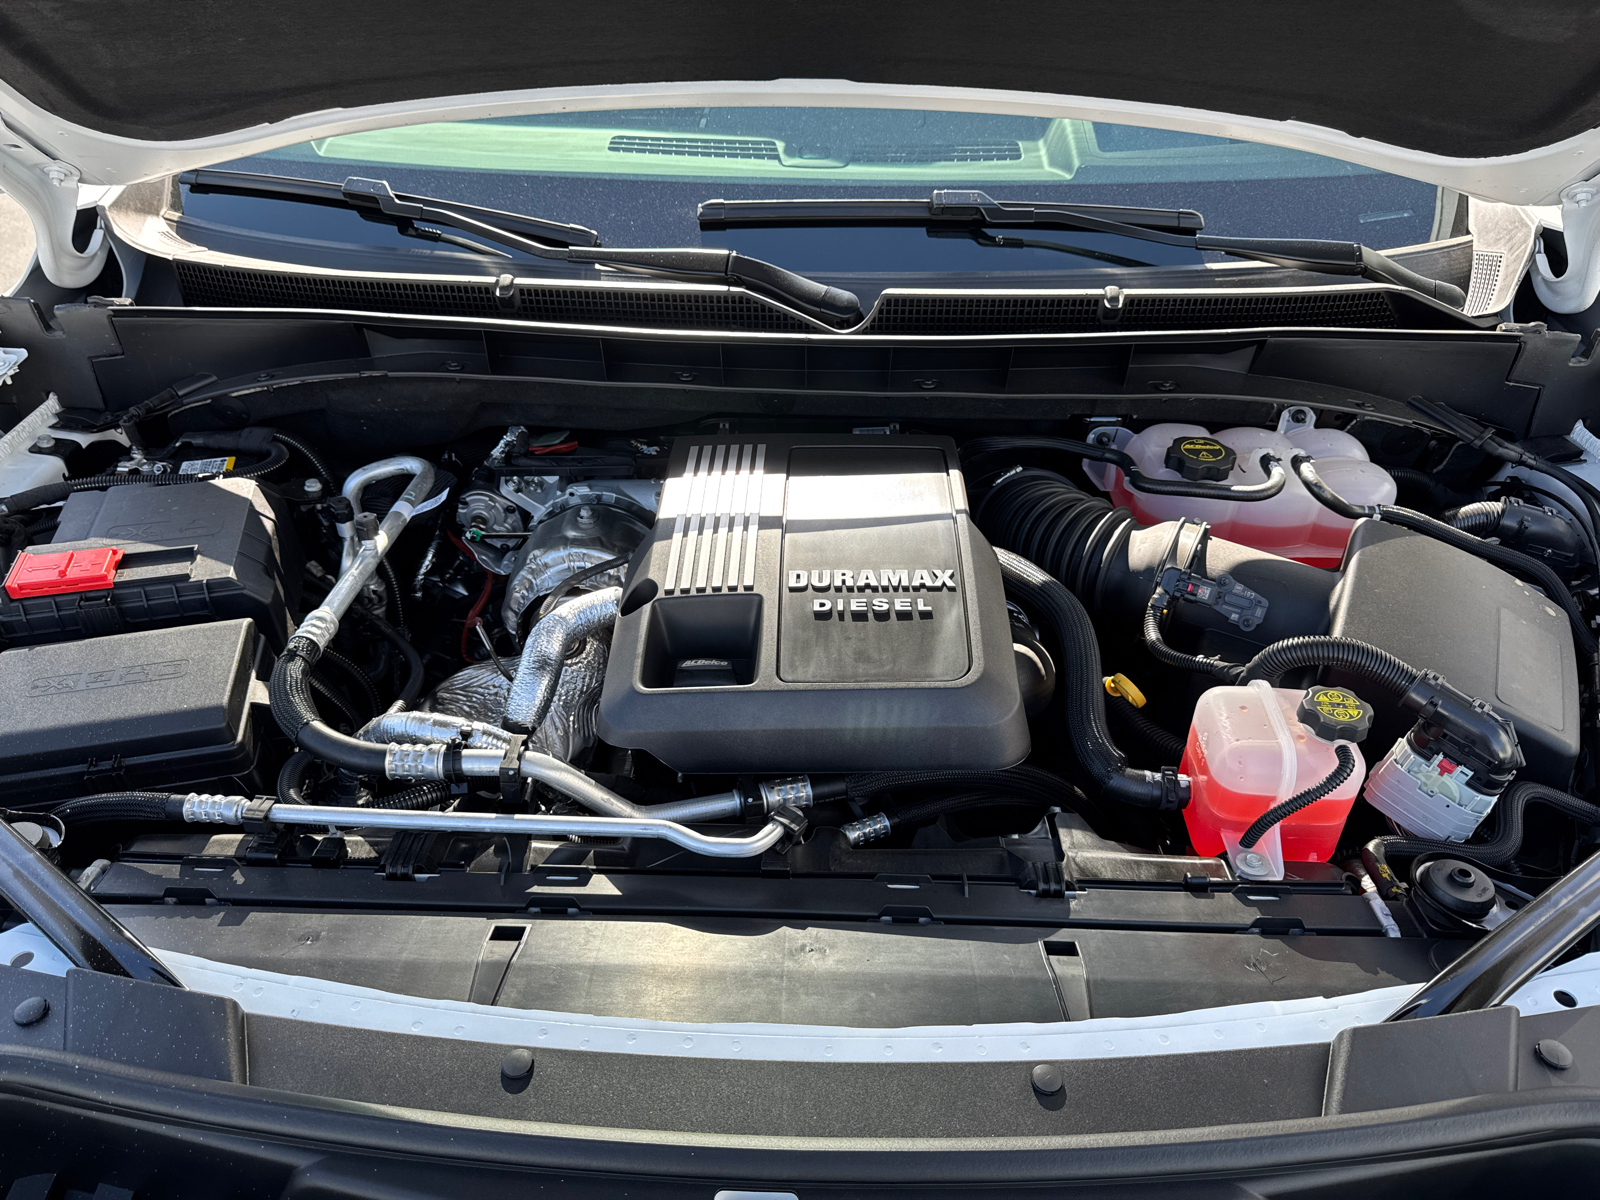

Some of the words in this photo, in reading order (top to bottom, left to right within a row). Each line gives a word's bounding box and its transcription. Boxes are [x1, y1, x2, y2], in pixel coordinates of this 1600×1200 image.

[788, 569, 956, 590] DURAMAX
[813, 598, 933, 614] DIESEL
[681, 659, 728, 667] ACDelco
